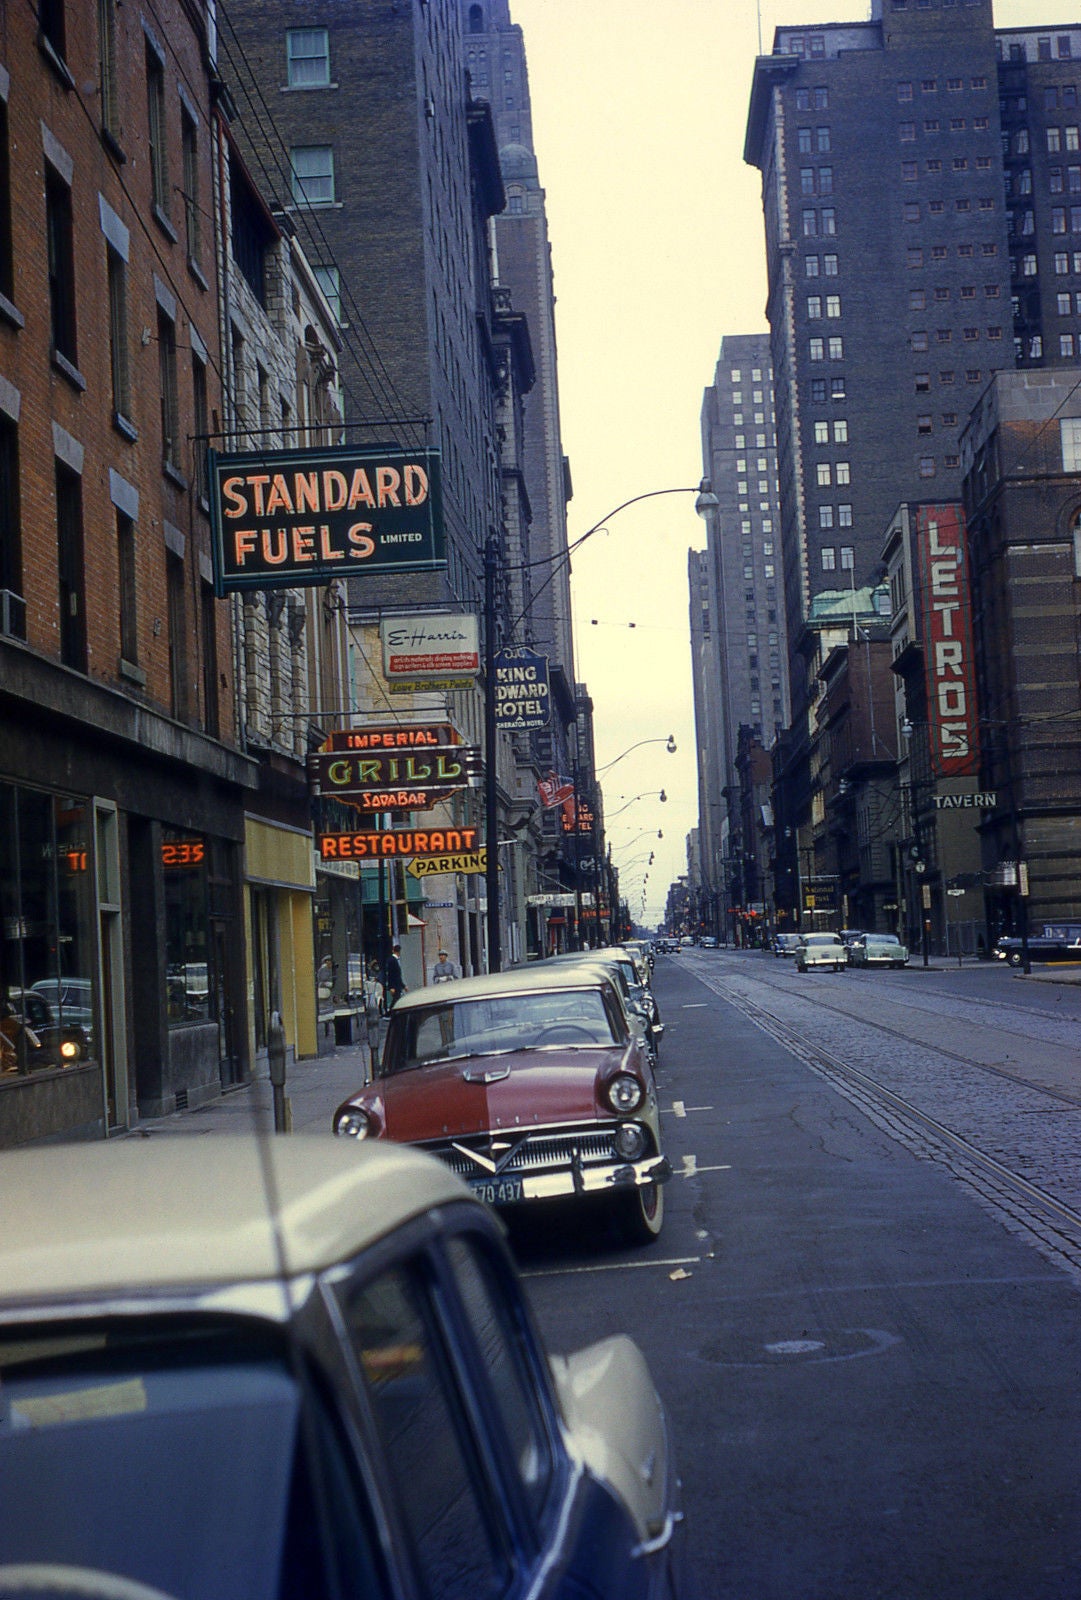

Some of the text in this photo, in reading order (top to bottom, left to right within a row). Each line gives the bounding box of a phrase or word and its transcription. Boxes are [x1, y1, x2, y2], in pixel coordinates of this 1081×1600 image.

[223, 464, 429, 519] STANDARD
[234, 522, 423, 566] FUELS LIMITED
[928, 521, 969, 758] LETROS
[496, 666, 537, 683] KING
[495, 683, 548, 700] DWARD
[495, 700, 546, 717] HOTEL
[496, 721, 526, 729] SHERATON
[347, 731, 438, 748] IMPERIAL
[328, 755, 462, 785] GRILL
[933, 793, 997, 809] TAVERN
[562, 813, 594, 822] EARD
[564, 822, 592, 831] HTEL
[322, 829, 476, 858] RESTAURANT
